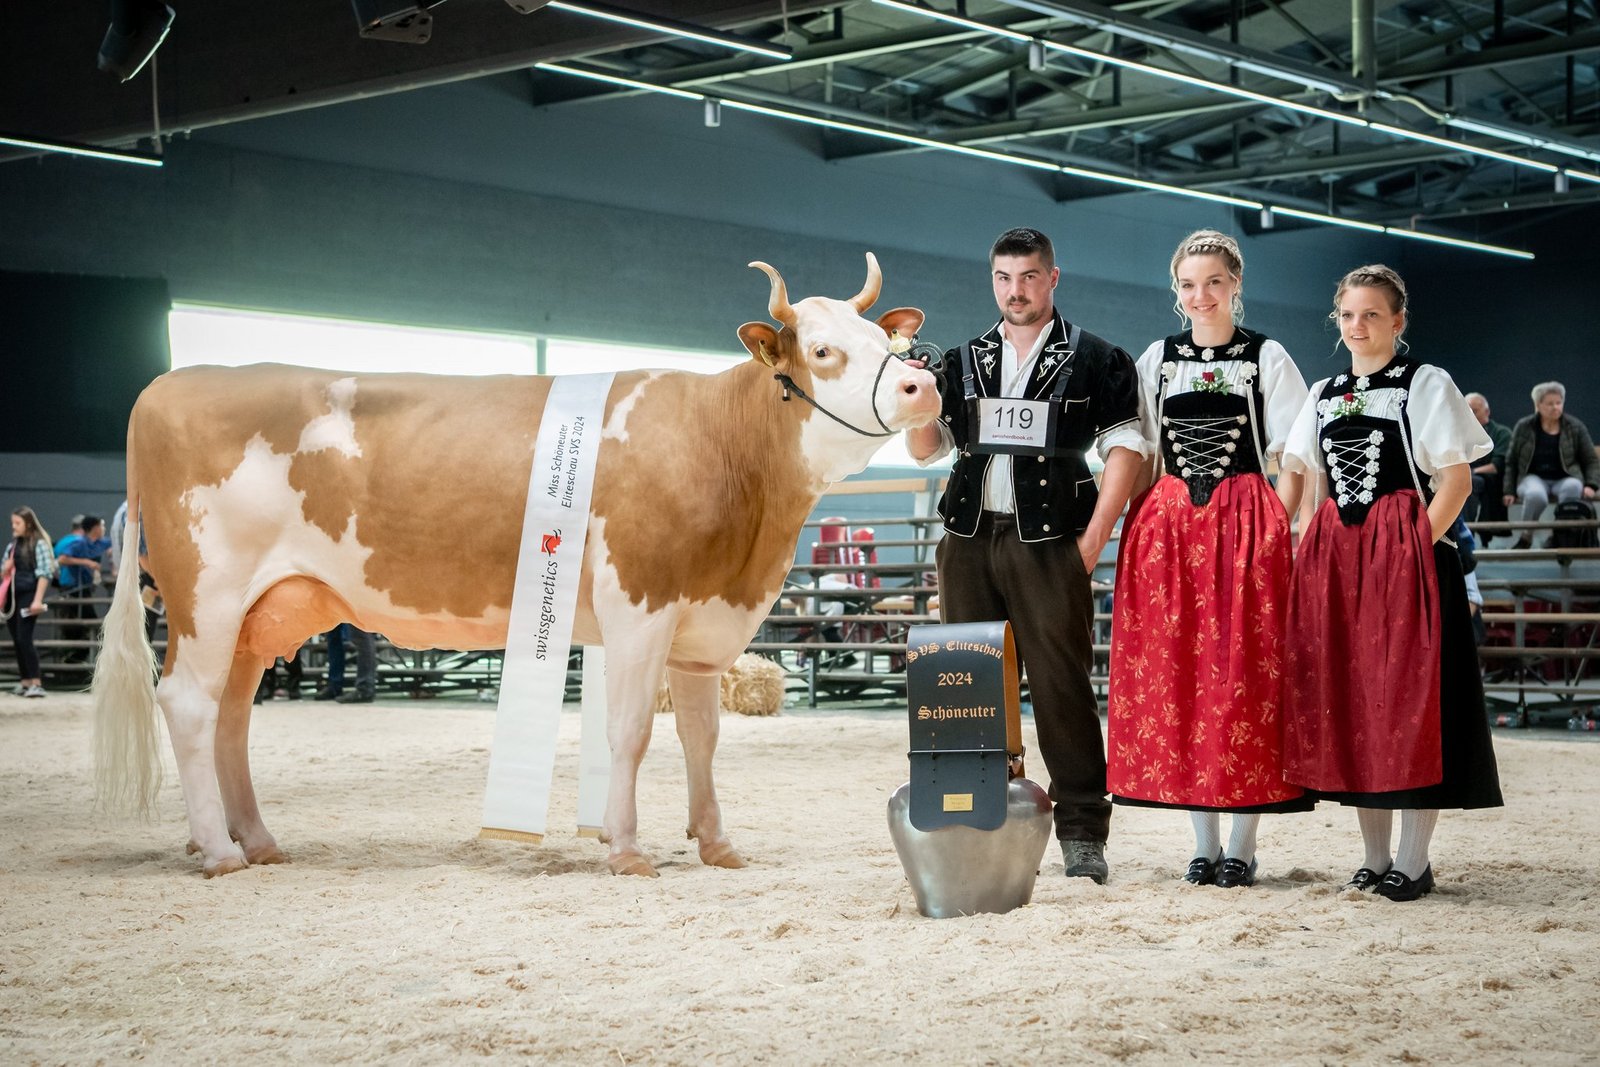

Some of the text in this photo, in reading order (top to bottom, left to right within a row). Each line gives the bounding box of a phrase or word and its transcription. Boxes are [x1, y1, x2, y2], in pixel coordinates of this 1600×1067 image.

[995, 406, 1033, 429] 119
[547, 424, 568, 498] Miss Schöneuter
[561, 416, 585, 509] Eliteschau SVS 2024
[534, 560, 559, 661] swissgenetics
[937, 672, 973, 687] 2024
[917, 705, 996, 721] Schöneuter
